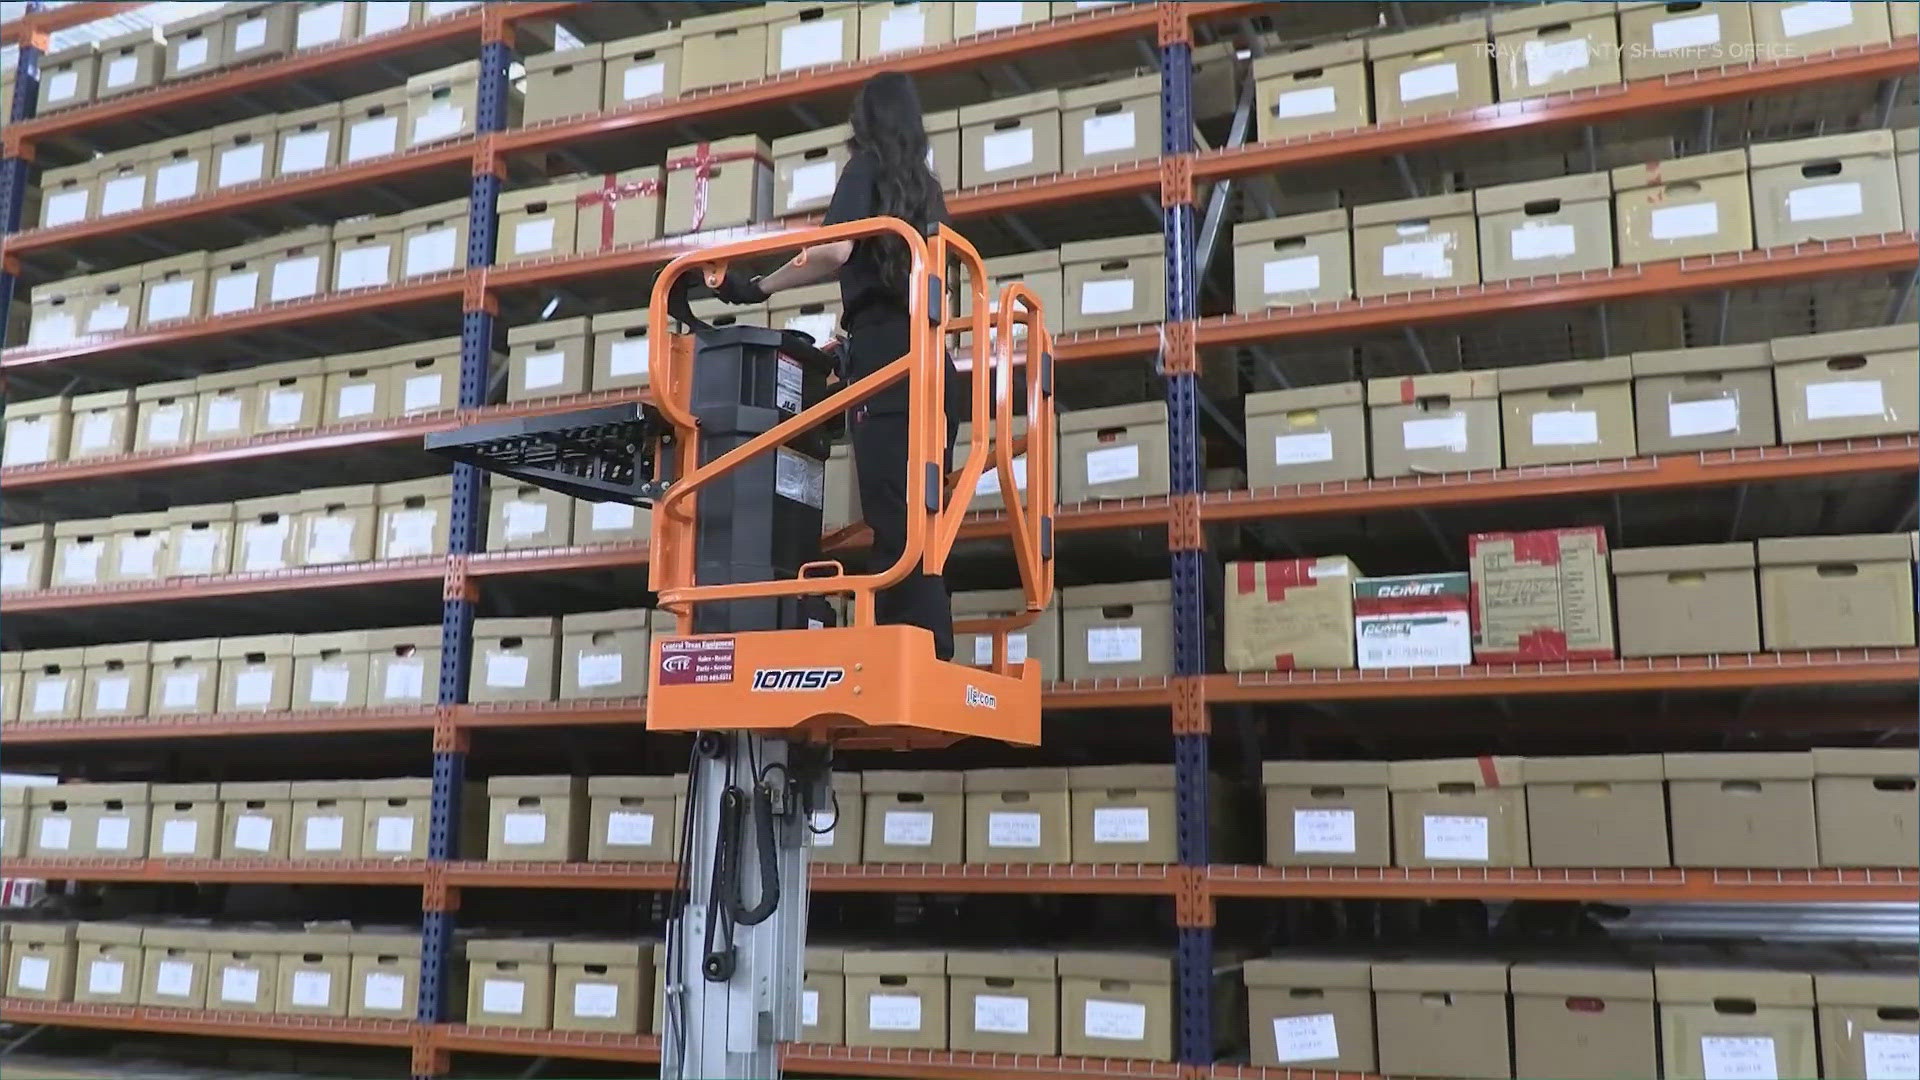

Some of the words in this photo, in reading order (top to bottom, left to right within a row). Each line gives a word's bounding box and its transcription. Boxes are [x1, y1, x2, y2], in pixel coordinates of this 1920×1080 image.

[782, 400, 796, 413] JLG
[1377, 582, 1445, 598] COMET
[753, 669, 844, 690] 10MSP
[966, 685, 996, 709] jlg.com
